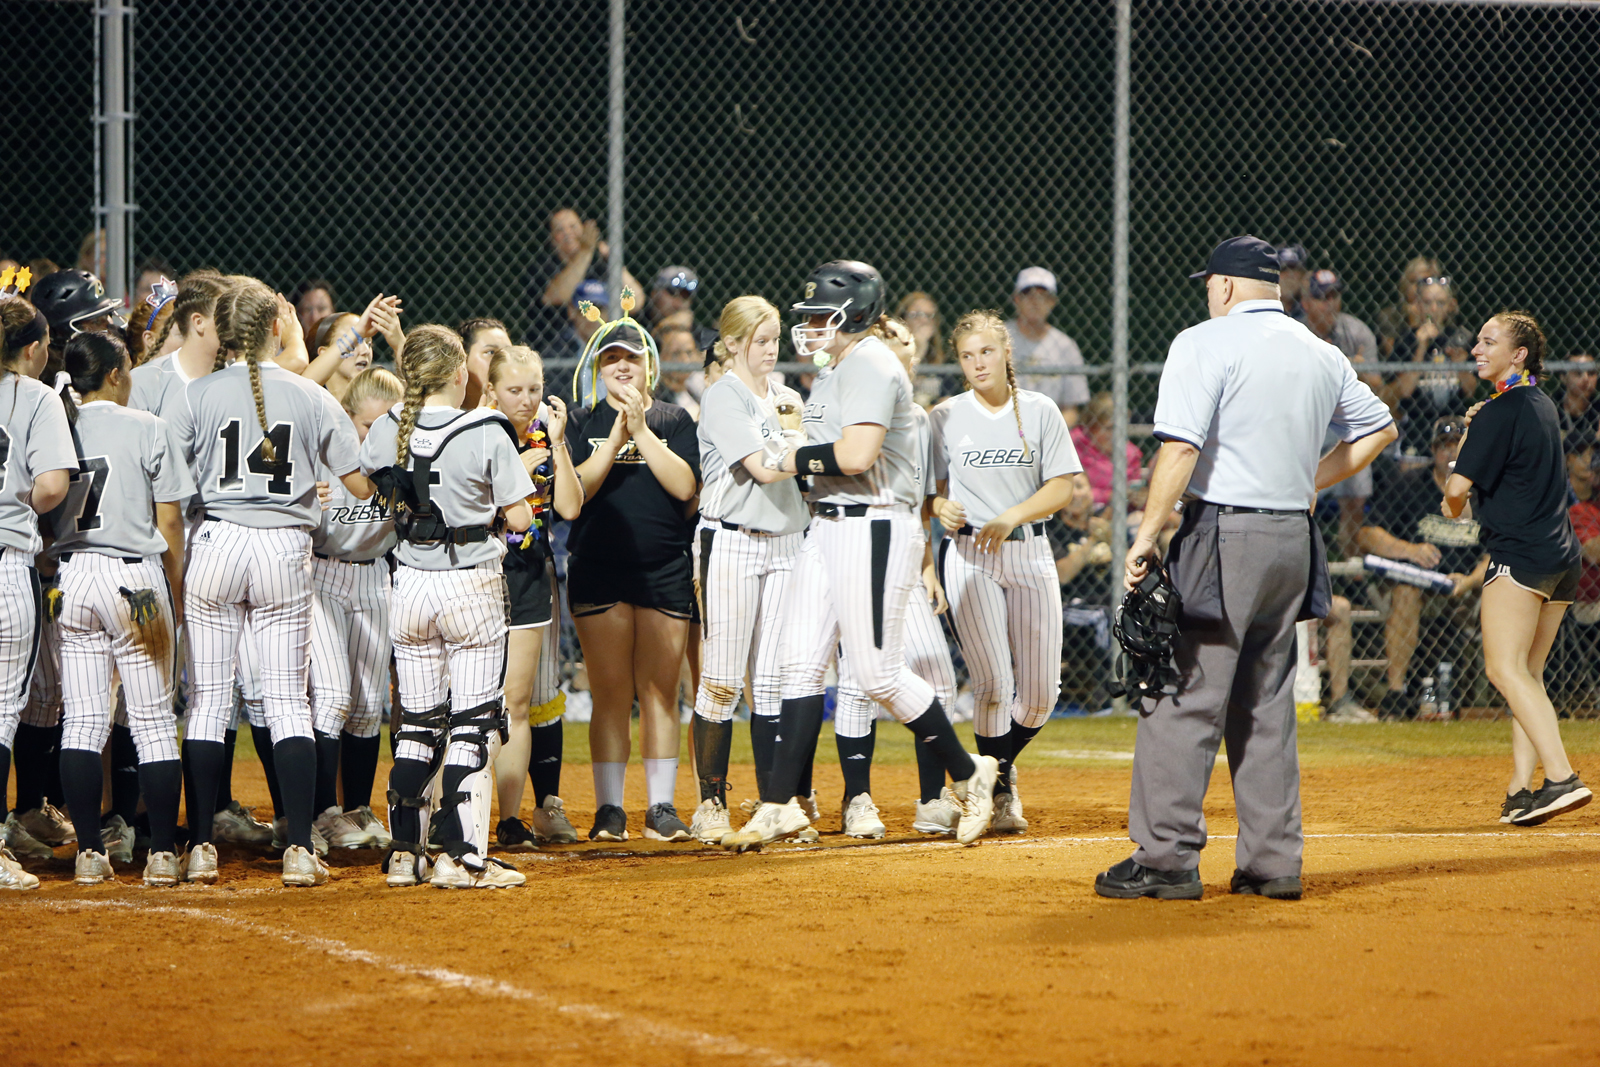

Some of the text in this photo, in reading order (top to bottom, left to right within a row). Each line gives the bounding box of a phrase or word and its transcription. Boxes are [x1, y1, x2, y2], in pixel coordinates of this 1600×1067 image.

[805, 281, 817, 299] B
[217, 417, 295, 497] 14
[962, 449, 1036, 468] REBELS
